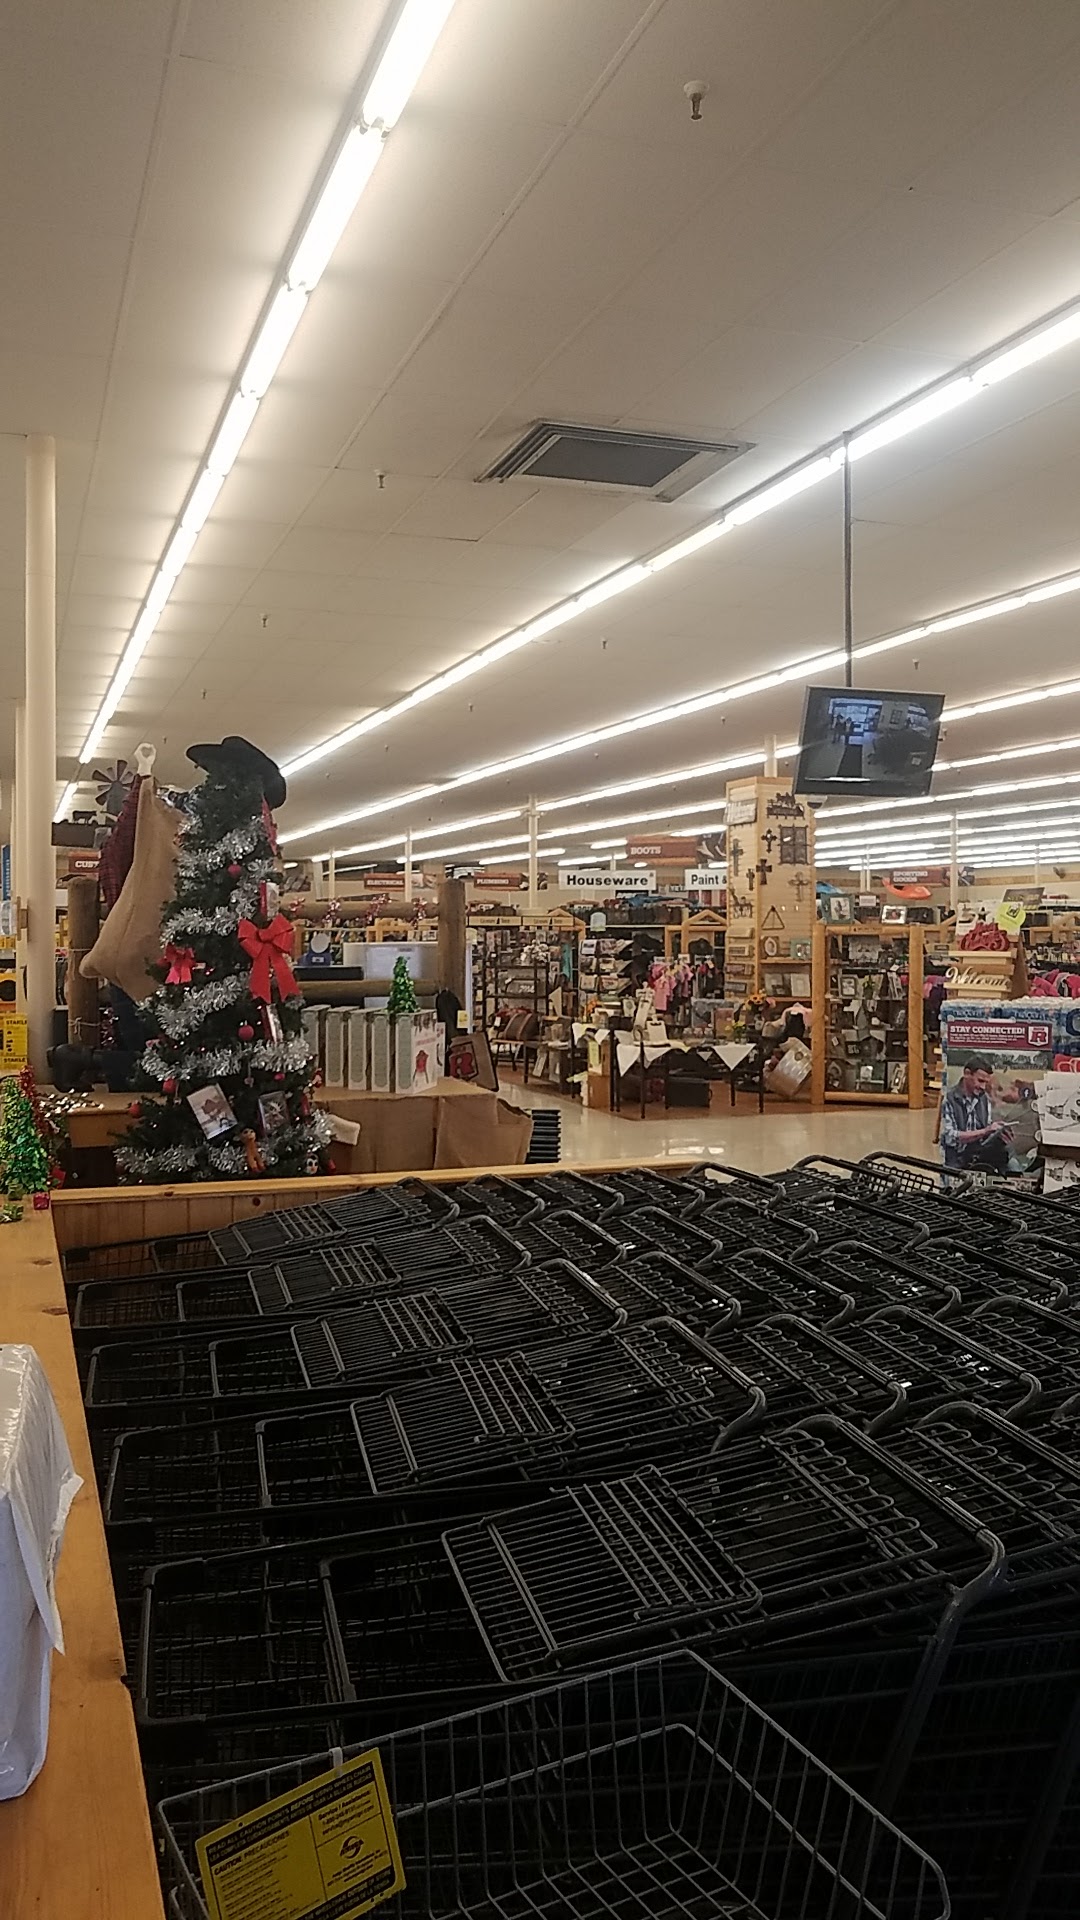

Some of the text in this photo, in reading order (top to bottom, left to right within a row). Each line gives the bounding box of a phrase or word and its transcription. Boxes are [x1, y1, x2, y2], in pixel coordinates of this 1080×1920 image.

[630, 846, 661, 855] BOOTS
[566, 874, 648, 886] Houseware
[691, 874, 719, 885] Paint
[946, 966, 1011, 988] Welcome
[972, 1026, 1025, 1034] CONNECTED!
[207, 1840, 226, 1854] READ
[239, 1819, 266, 1838] CAUTION
[267, 1806, 289, 1823] POINTS
[289, 1793, 314, 1811] BEFORE
